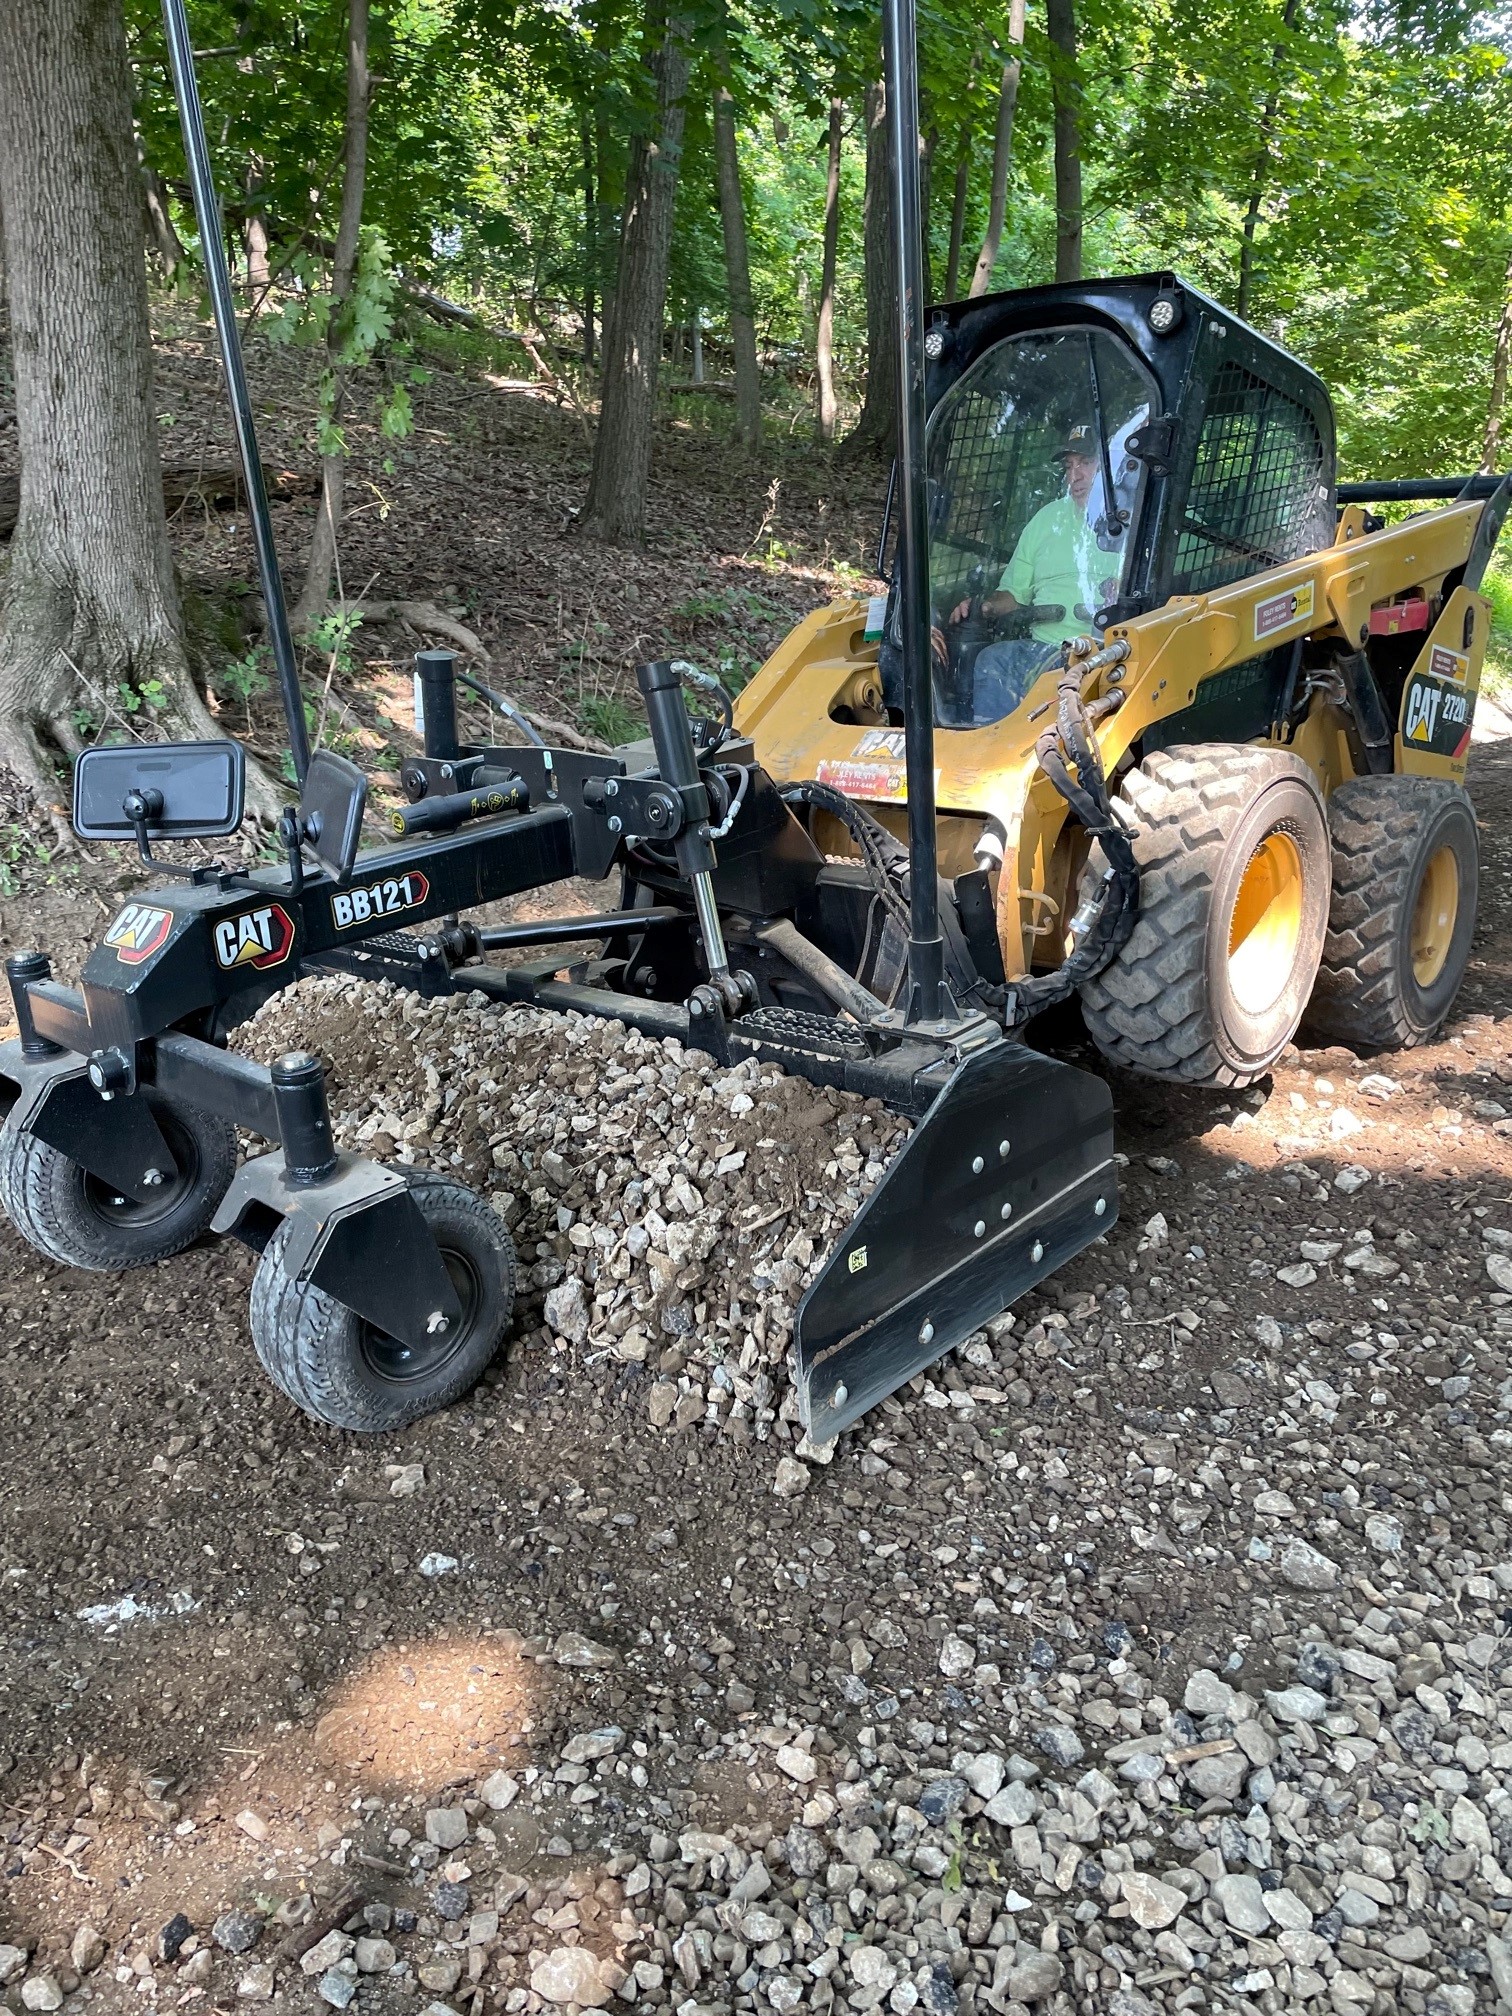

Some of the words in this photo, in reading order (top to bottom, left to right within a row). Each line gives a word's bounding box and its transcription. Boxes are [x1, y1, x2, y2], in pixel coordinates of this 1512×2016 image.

[1069, 425, 1091, 440] CAT
[1406, 683, 1441, 742] CAT
[333, 876, 413, 926] BB121
[106, 905, 167, 949] CAT
[215, 908, 273, 966] CAT
